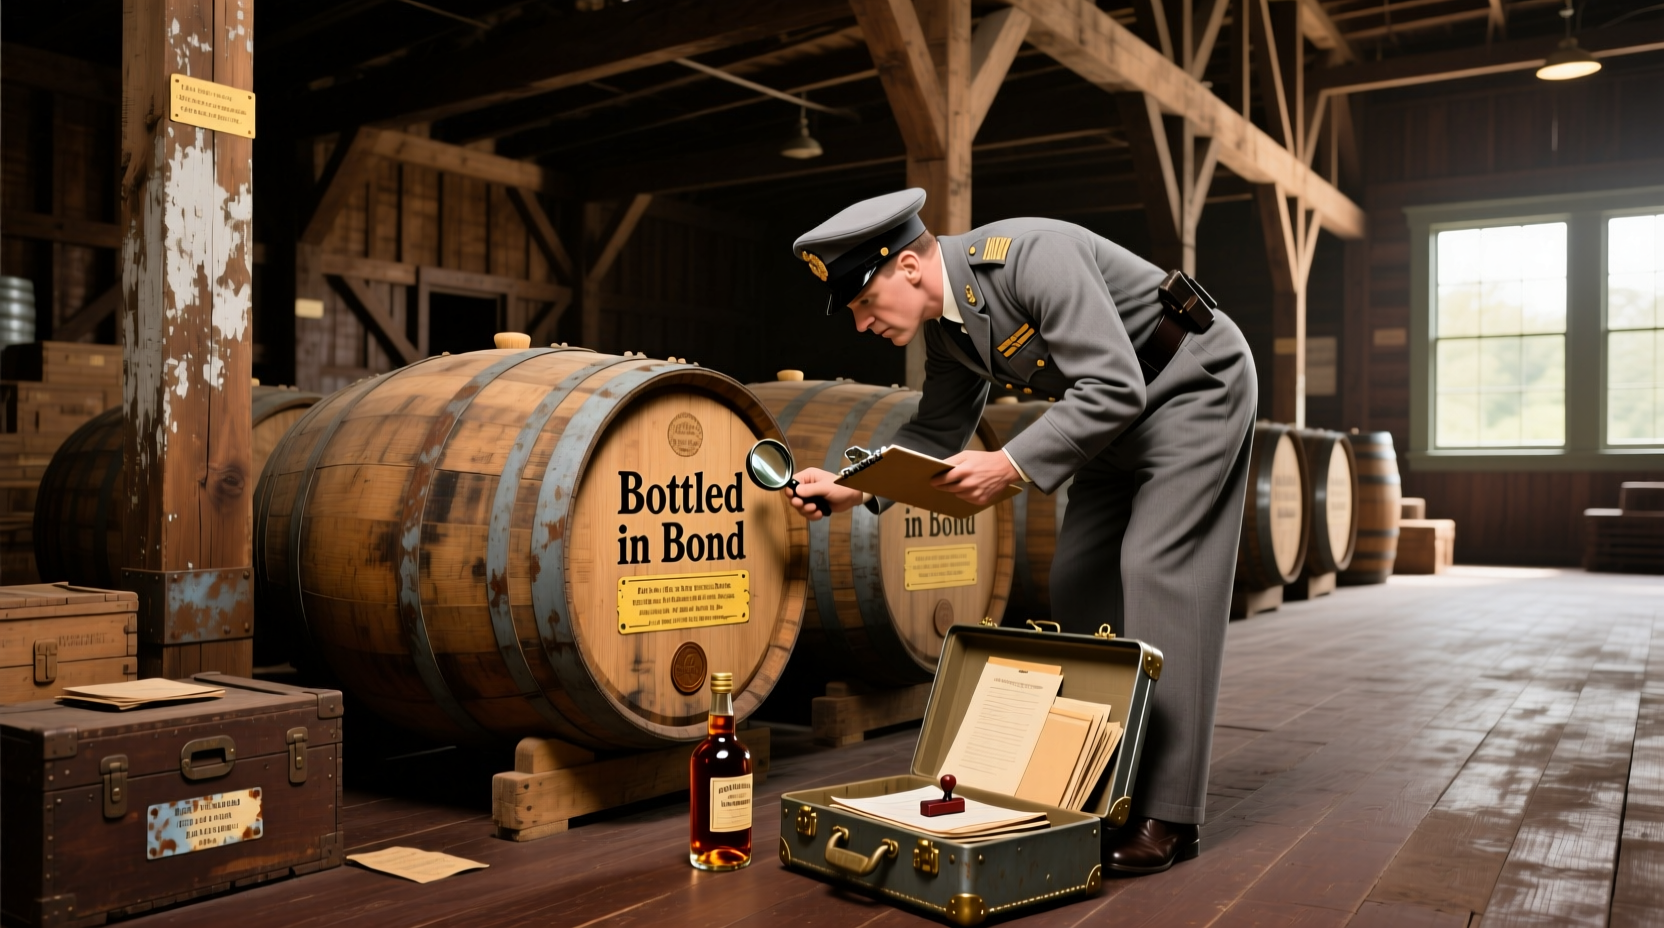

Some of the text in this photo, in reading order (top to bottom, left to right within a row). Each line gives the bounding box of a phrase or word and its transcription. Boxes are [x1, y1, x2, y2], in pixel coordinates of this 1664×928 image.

[618, 471, 745, 514] Bottled
[617, 520, 746, 565] in Bond
[904, 507, 923, 538] in
